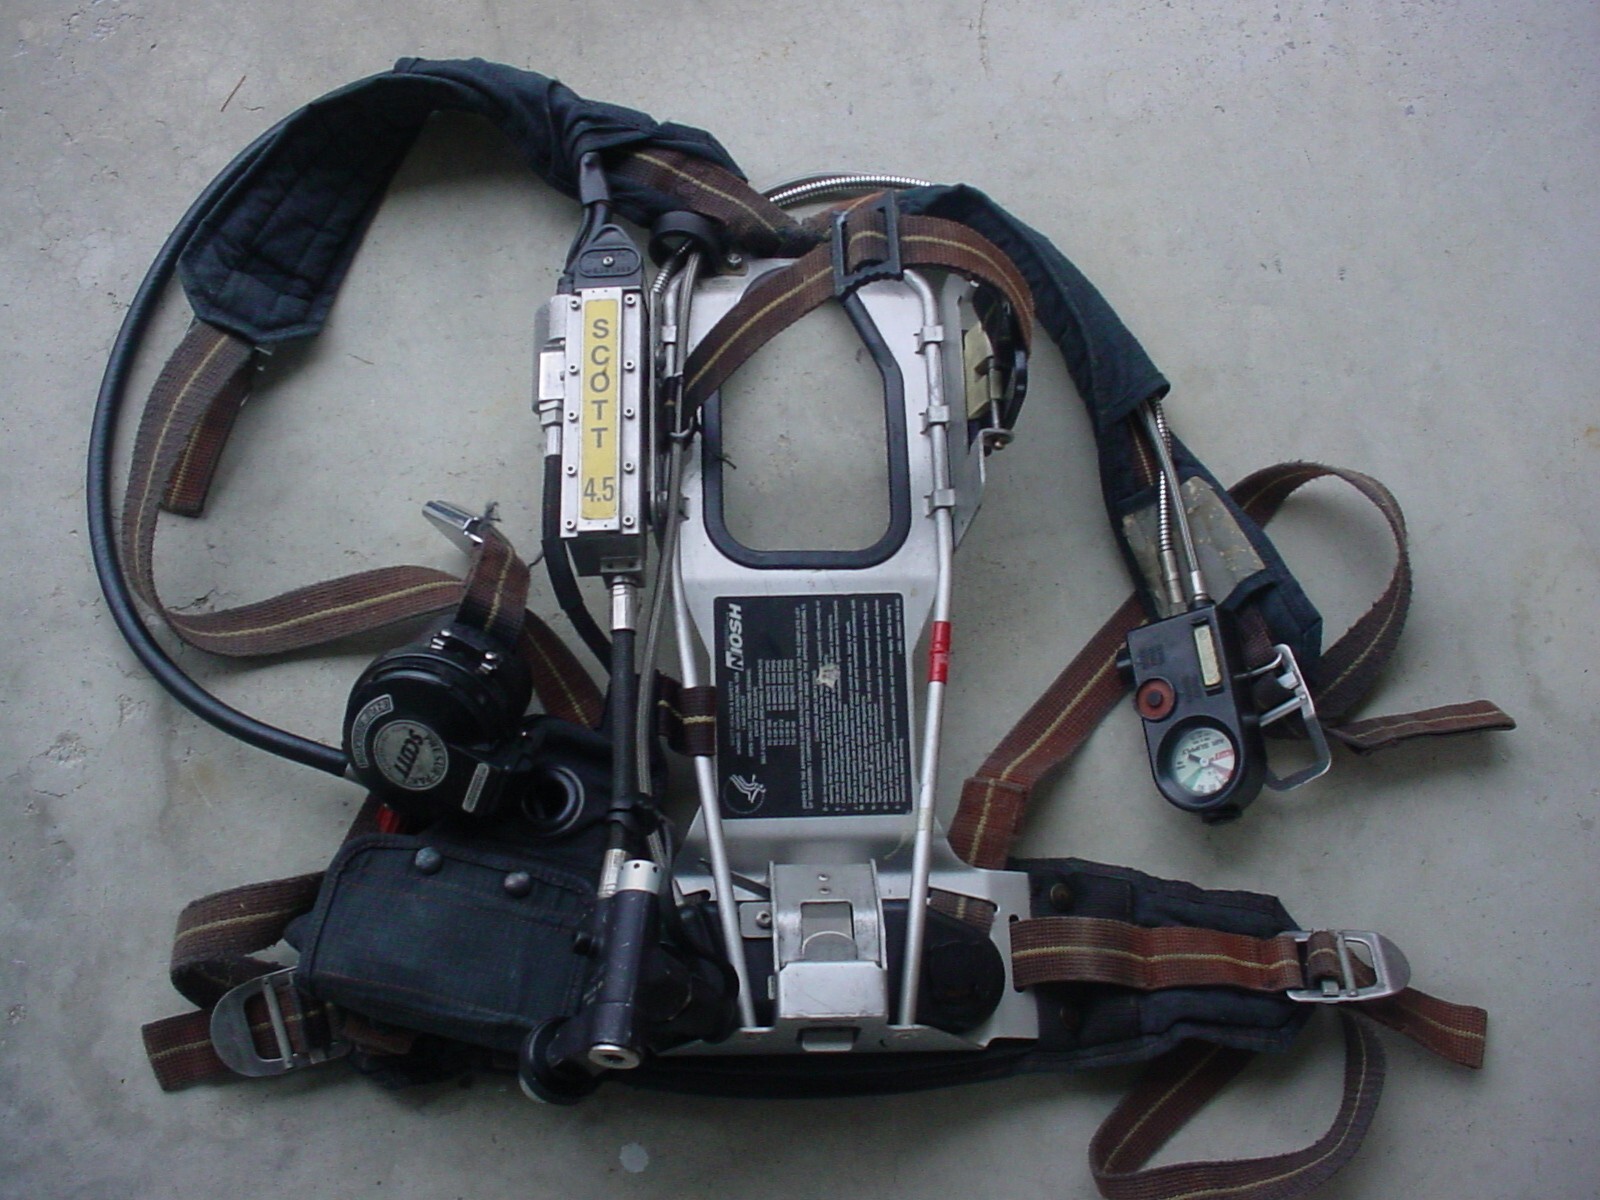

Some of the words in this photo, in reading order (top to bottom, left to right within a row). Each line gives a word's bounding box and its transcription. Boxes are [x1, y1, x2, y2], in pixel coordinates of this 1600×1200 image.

[590, 319, 610, 448] SCOTT
[583, 476, 615, 503] 4.5
[725, 603, 744, 671] NIOSH
[394, 728, 423, 779] SCOTT
